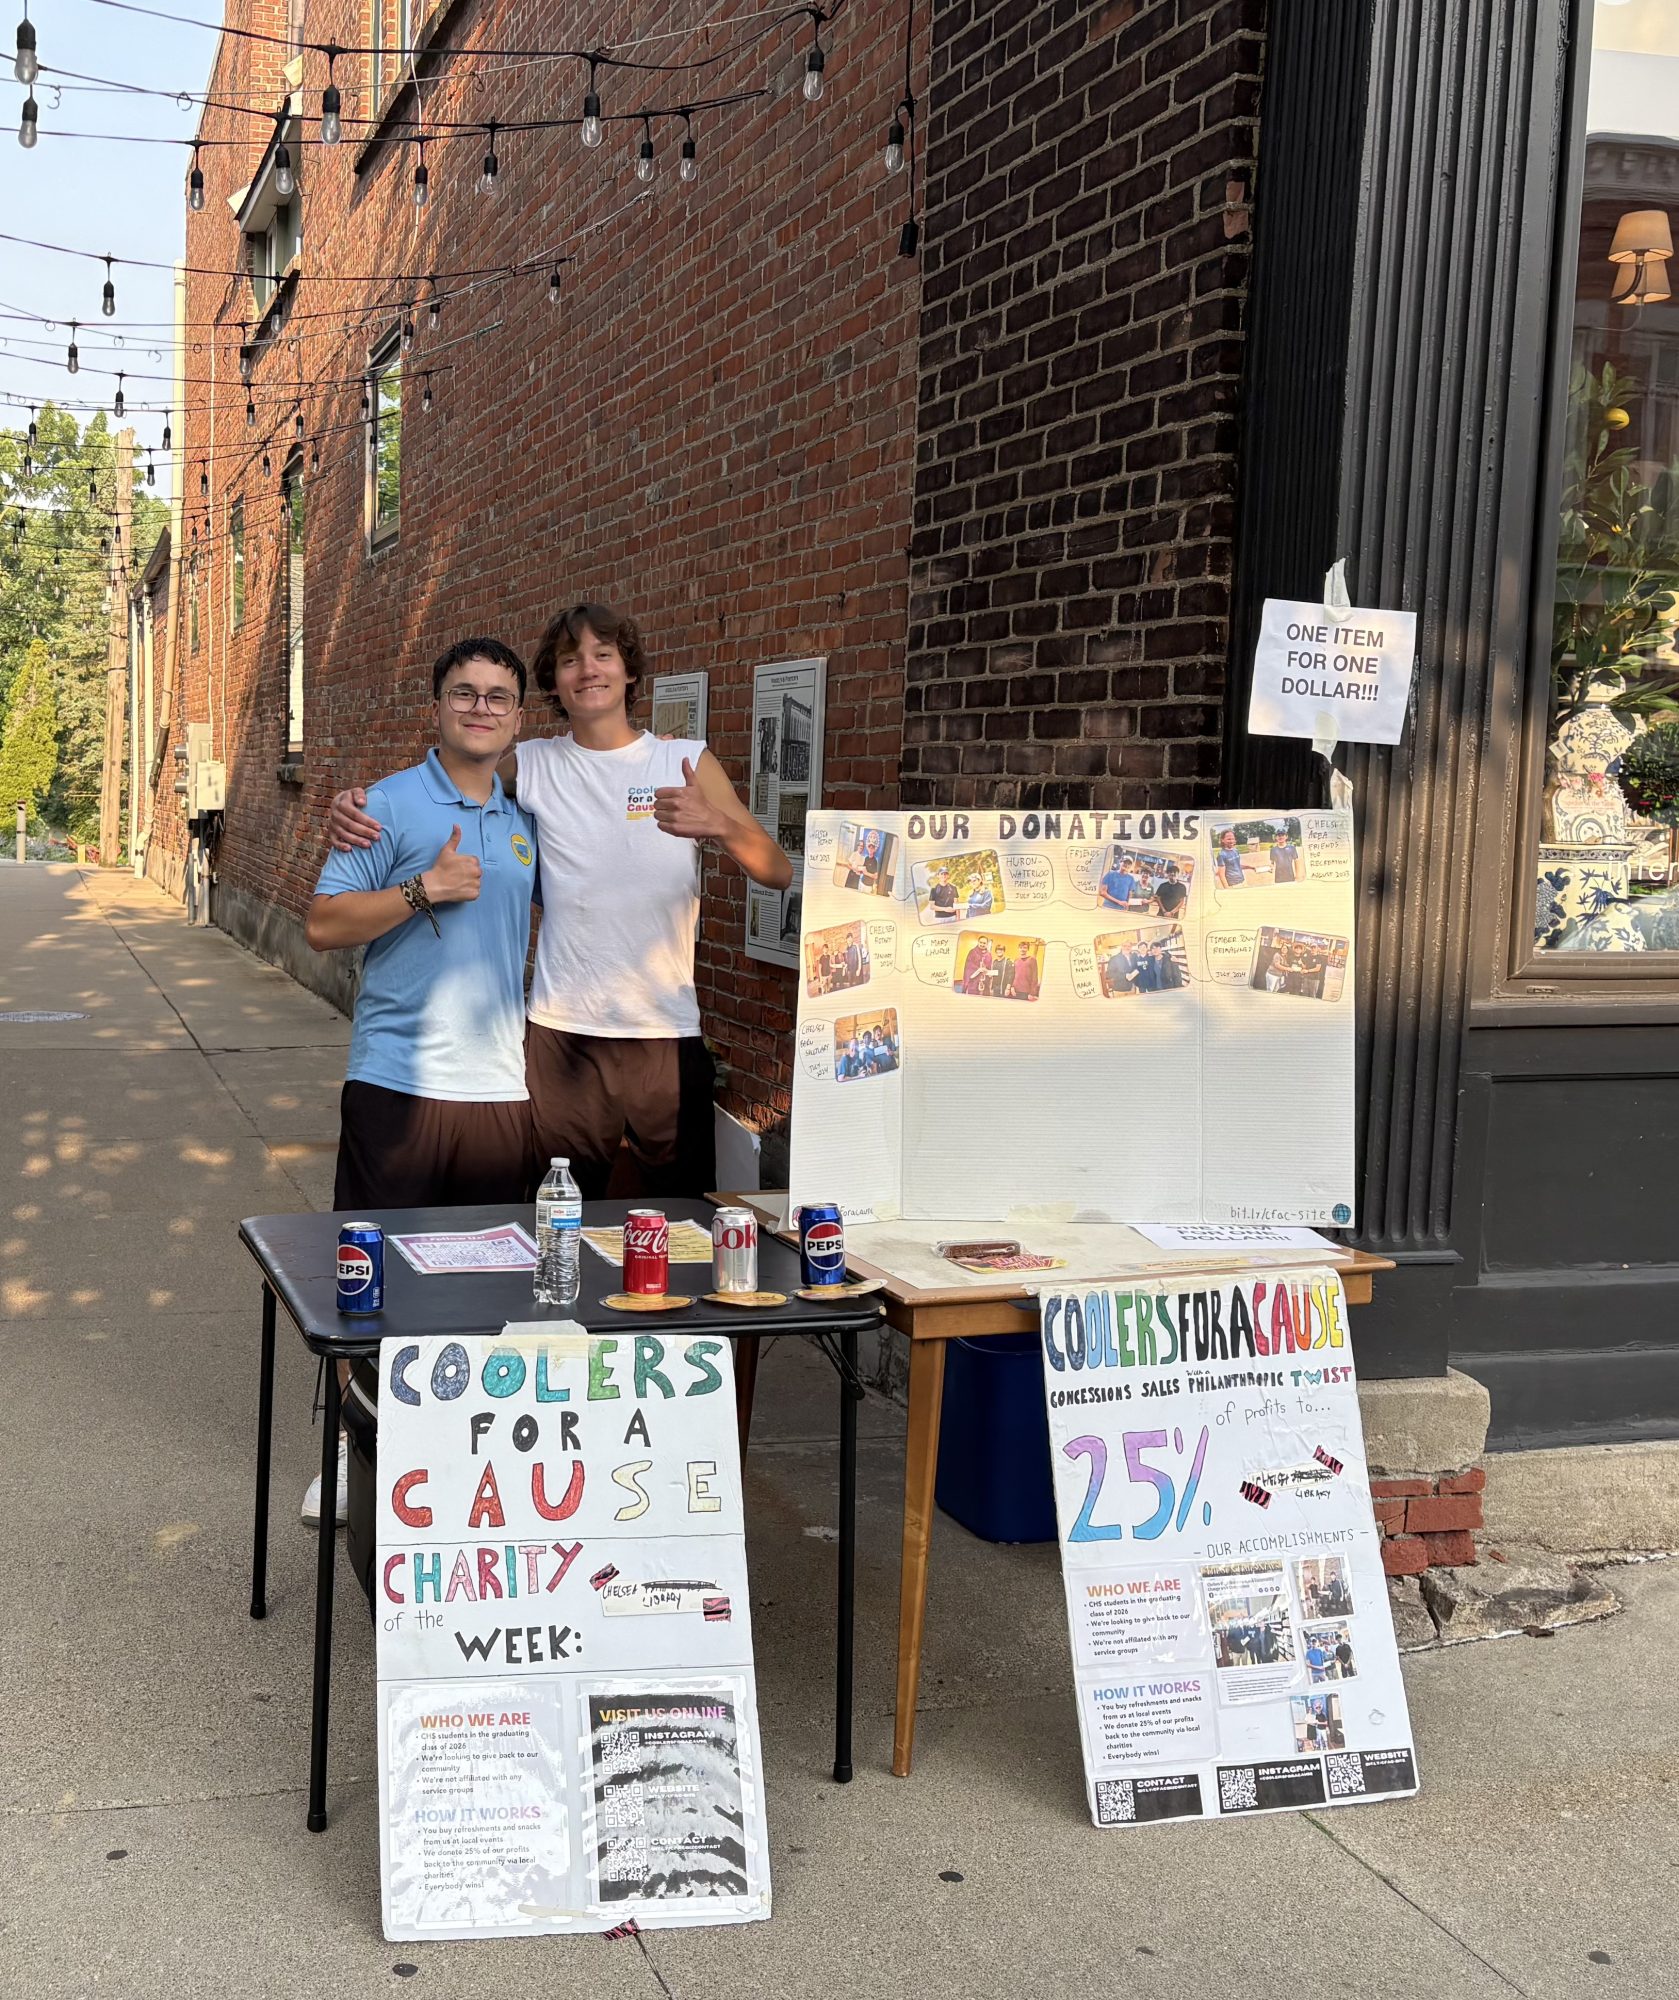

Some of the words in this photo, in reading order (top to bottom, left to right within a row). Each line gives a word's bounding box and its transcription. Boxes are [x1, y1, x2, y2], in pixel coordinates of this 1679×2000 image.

[1286, 623, 1328, 643] ONE
[1333, 627, 1383, 648] ITEM
[1287, 651, 1326, 670] FOR
[1333, 655, 1378, 674] ONE
[1281, 677, 1379, 701] DOLLAR!!!
[628, 795, 644, 803] for
[627, 804, 656, 812] Caus
[907, 814, 970, 840] OUR
[1000, 812, 1199, 841] DONATIONS
[1009, 869, 1049, 879] WATERLOO
[337, 1262, 369, 1276] EPSI
[390, 1336, 723, 1406] COOLERS
[1050, 1384, 1132, 1408] CONCESSIONS
[1141, 1379, 1180, 1397] SALES
[1188, 1371, 1284, 1393] PHILANTHROPIC
[1290, 1366, 1352, 1388] TWIST
[1215, 1401, 1236, 1426] of
[1245, 1399, 1286, 1425] profits
[470, 1411, 582, 1455] FOR
[623, 1408, 652, 1448] A
[1063, 1425, 1212, 1543] 25%
[391, 1460, 722, 1528] CAUSE
[1207, 1542, 1232, 1558] OUR
[1239, 1528, 1354, 1554] ACCOMPLISHMENTS
[383, 1541, 584, 1604] CHARITY
[602, 1584, 638, 1599] CHELSEA
[1086, 1584, 1124, 1597] WHO
[1127, 1582, 1150, 1593] WE
[1154, 1579, 1181, 1591] ARE
[642, 1592, 681, 1610] LIBRARY
[383, 1611, 405, 1632] of
[414, 1609, 444, 1630] the
[454, 1624, 583, 1664] WEEK:
[1093, 1687, 1129, 1701] HOW
[1133, 1685, 1145, 1697] IT
[1148, 1680, 1200, 1695] WORKS
[1129, 1700, 1168, 1708] refreshments
[420, 1715, 463, 1728] WHO
[468, 1714, 494, 1726] WE
[499, 1712, 531, 1725] ARE
[600, 1709, 640, 1722] VISIT
[645, 1708, 667, 1719] US
[669, 1706, 726, 1719] ONLINE
[1174, 1716, 1193, 1724] profits
[438, 1731, 468, 1739] students
[492, 1730, 529, 1738] graduating
[644, 1731, 715, 1739] INSTAGRAM
[1142, 1728, 1174, 1736] community
[445, 1753, 470, 1762] looking
[482, 1753, 496, 1761] give
[1108, 1752, 1141, 1760] Everybody
[1364, 1750, 1408, 1761] WEBSITE
[1258, 1763, 1320, 1775] INSTAGRAM
[648, 1784, 699, 1793] WEBSITE
[1137, 1777, 1184, 1788] CONTACT
[415, 1809, 456, 1822] HOW
[460, 1808, 476, 1821] IT
[480, 1806, 540, 1820] WORKS
[651, 1836, 707, 1845] CONTACT
